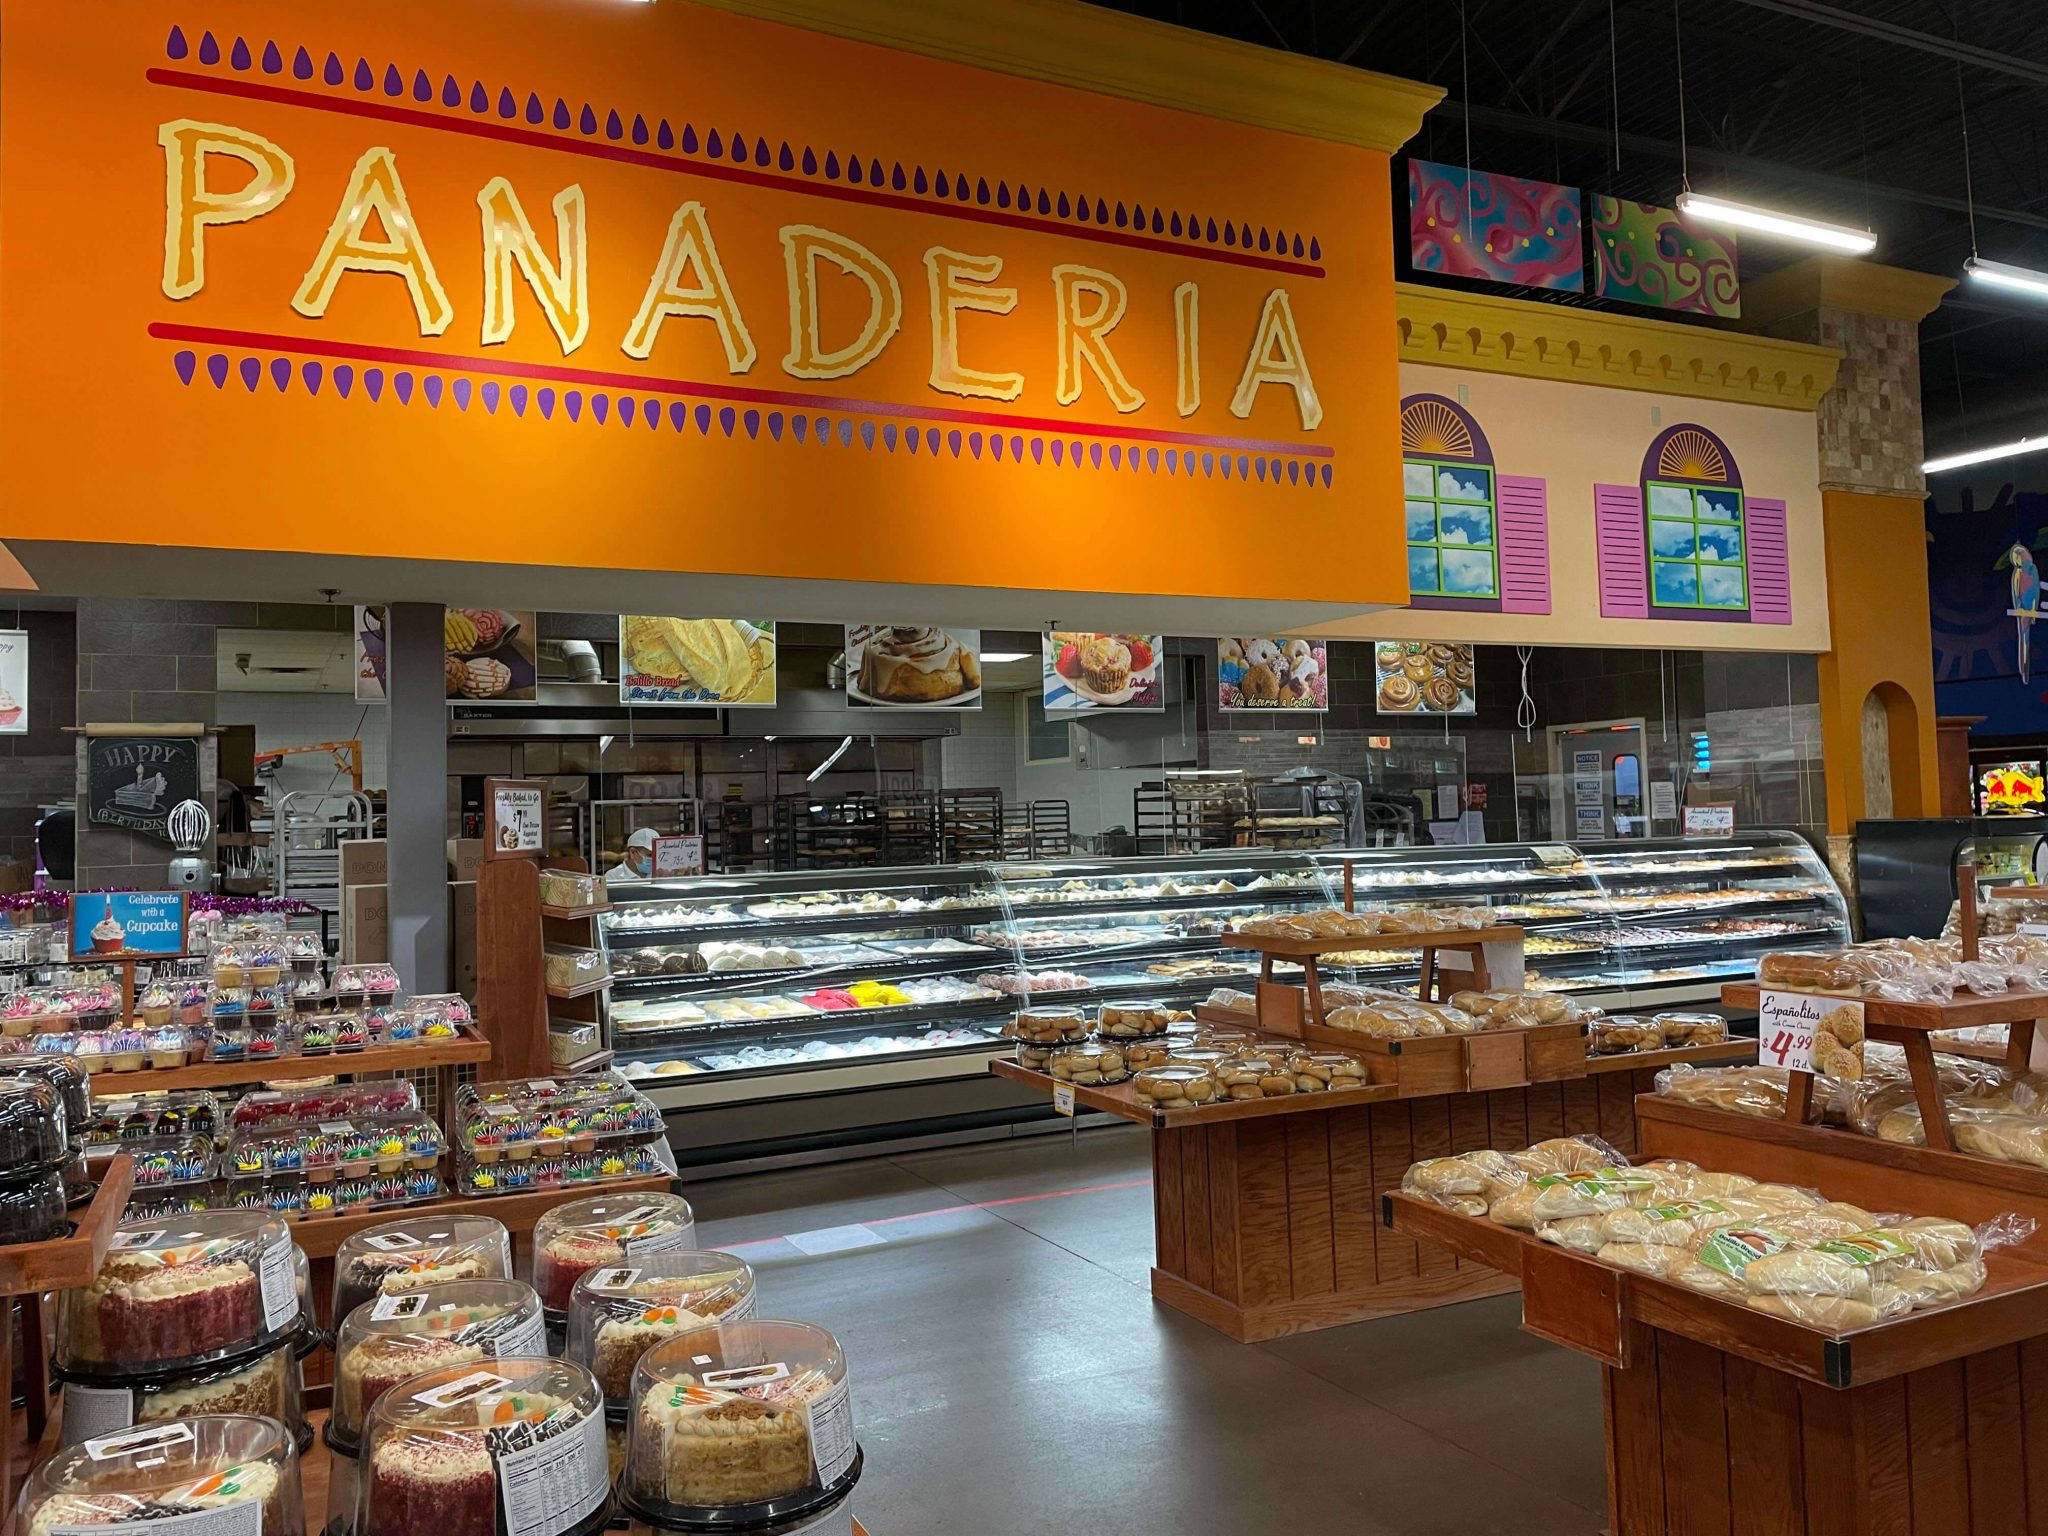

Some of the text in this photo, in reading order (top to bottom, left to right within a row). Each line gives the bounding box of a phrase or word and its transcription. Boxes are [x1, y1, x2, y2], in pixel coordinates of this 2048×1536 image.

[158, 118, 1324, 431] PANADERIA
[625, 673, 682, 687] Bolillo Bread
[657, 688, 680, 701] from
[682, 688, 697, 699] the
[1230, 692, 1244, 707] You
[1248, 694, 1279, 707] deserve
[1290, 693, 1317, 708] treat!
[104, 744, 177, 766] HAPPY
[128, 894, 179, 904] Celebrate
[141, 907, 165, 917] with a
[127, 919, 179, 935] Cupcake
[1761, 995, 1820, 1020] Españolitos
[1792, 1058, 1800, 1068] 12
[1718, 1233, 1740, 1247] Bolillo
[1740, 1242, 1762, 1260] Bread
